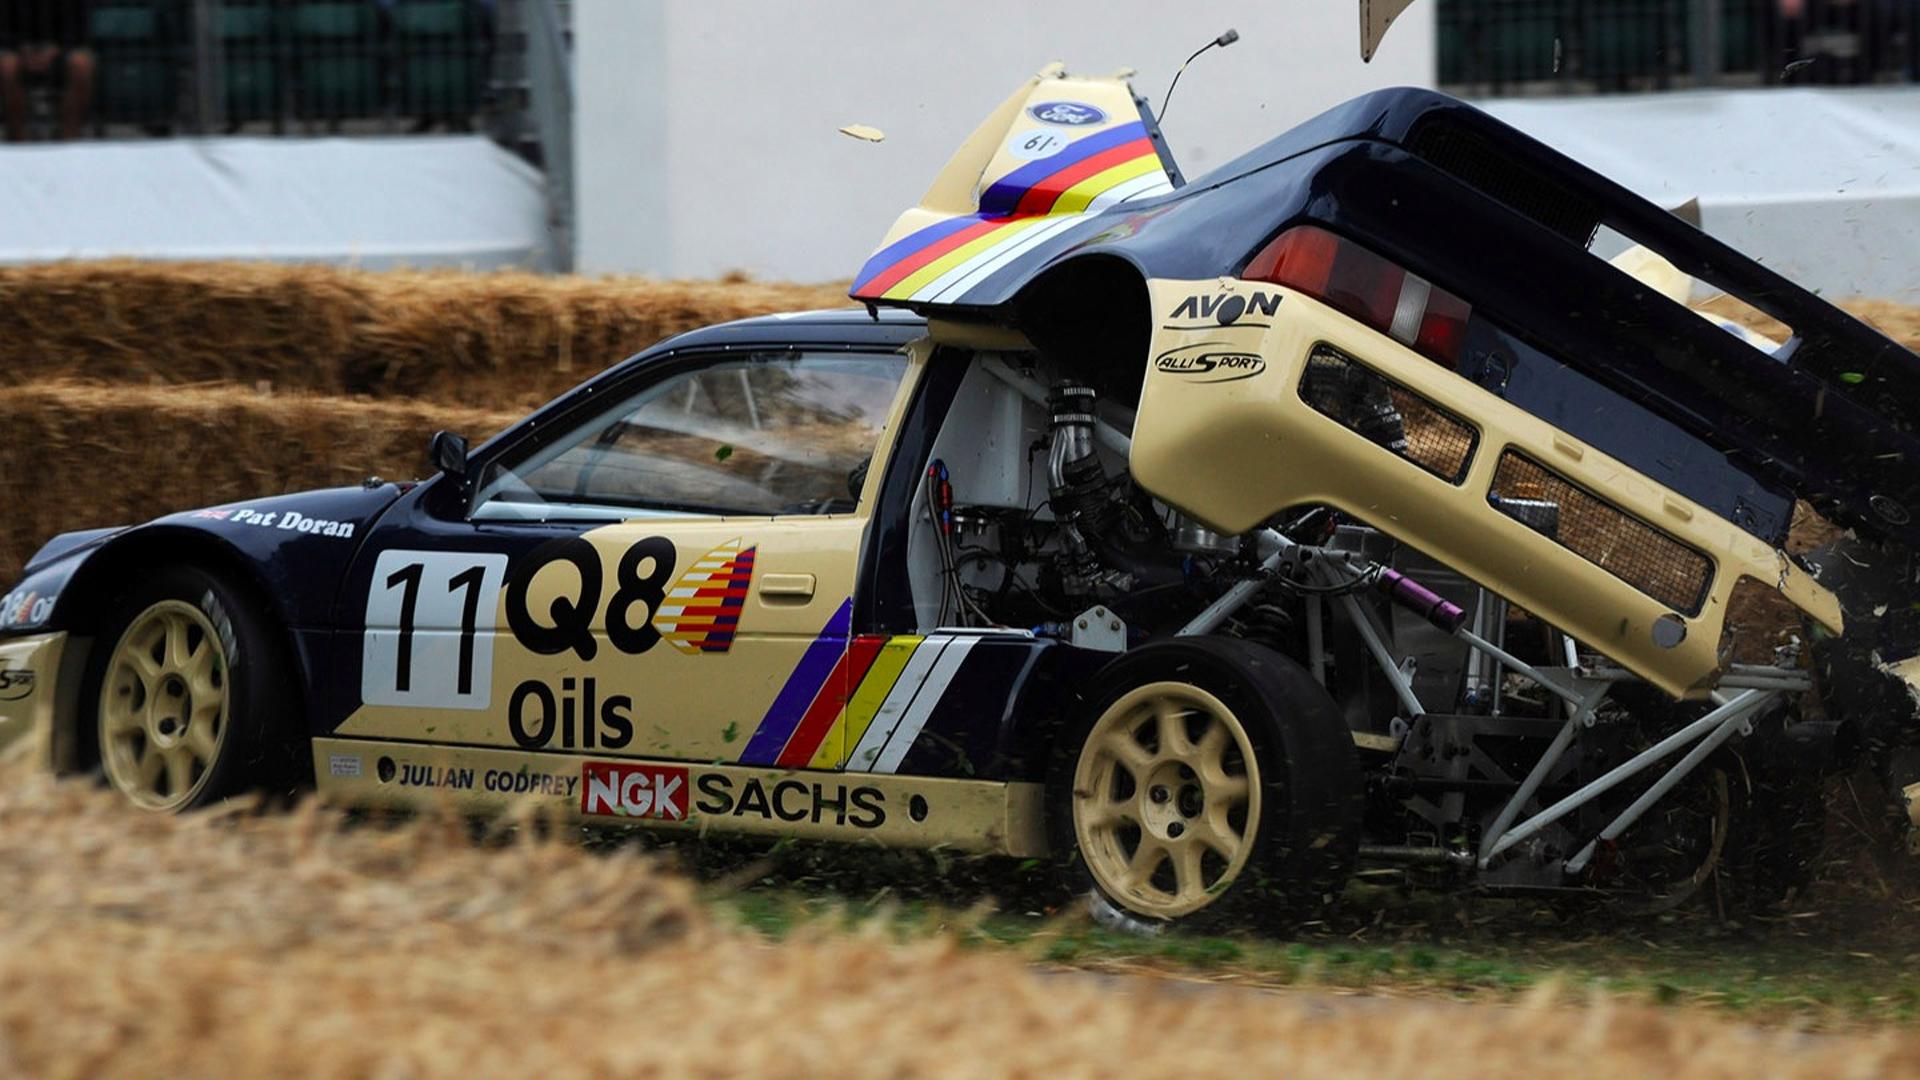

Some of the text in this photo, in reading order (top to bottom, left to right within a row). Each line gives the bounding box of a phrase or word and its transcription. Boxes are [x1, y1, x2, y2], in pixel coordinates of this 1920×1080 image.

[1041, 104, 1093, 124] Ford
[1169, 292, 1283, 326] AVON
[1158, 353, 1263, 373] ALLISPORT
[230, 509, 355, 538] Pat Doran
[505, 536, 677, 662] Q8
[387, 563, 487, 695] 11
[508, 677, 634, 750] Oils
[400, 764, 578, 797] JULIAN GODFREY
[587, 769, 683, 820] NGK
[696, 773, 886, 828] SACHS
